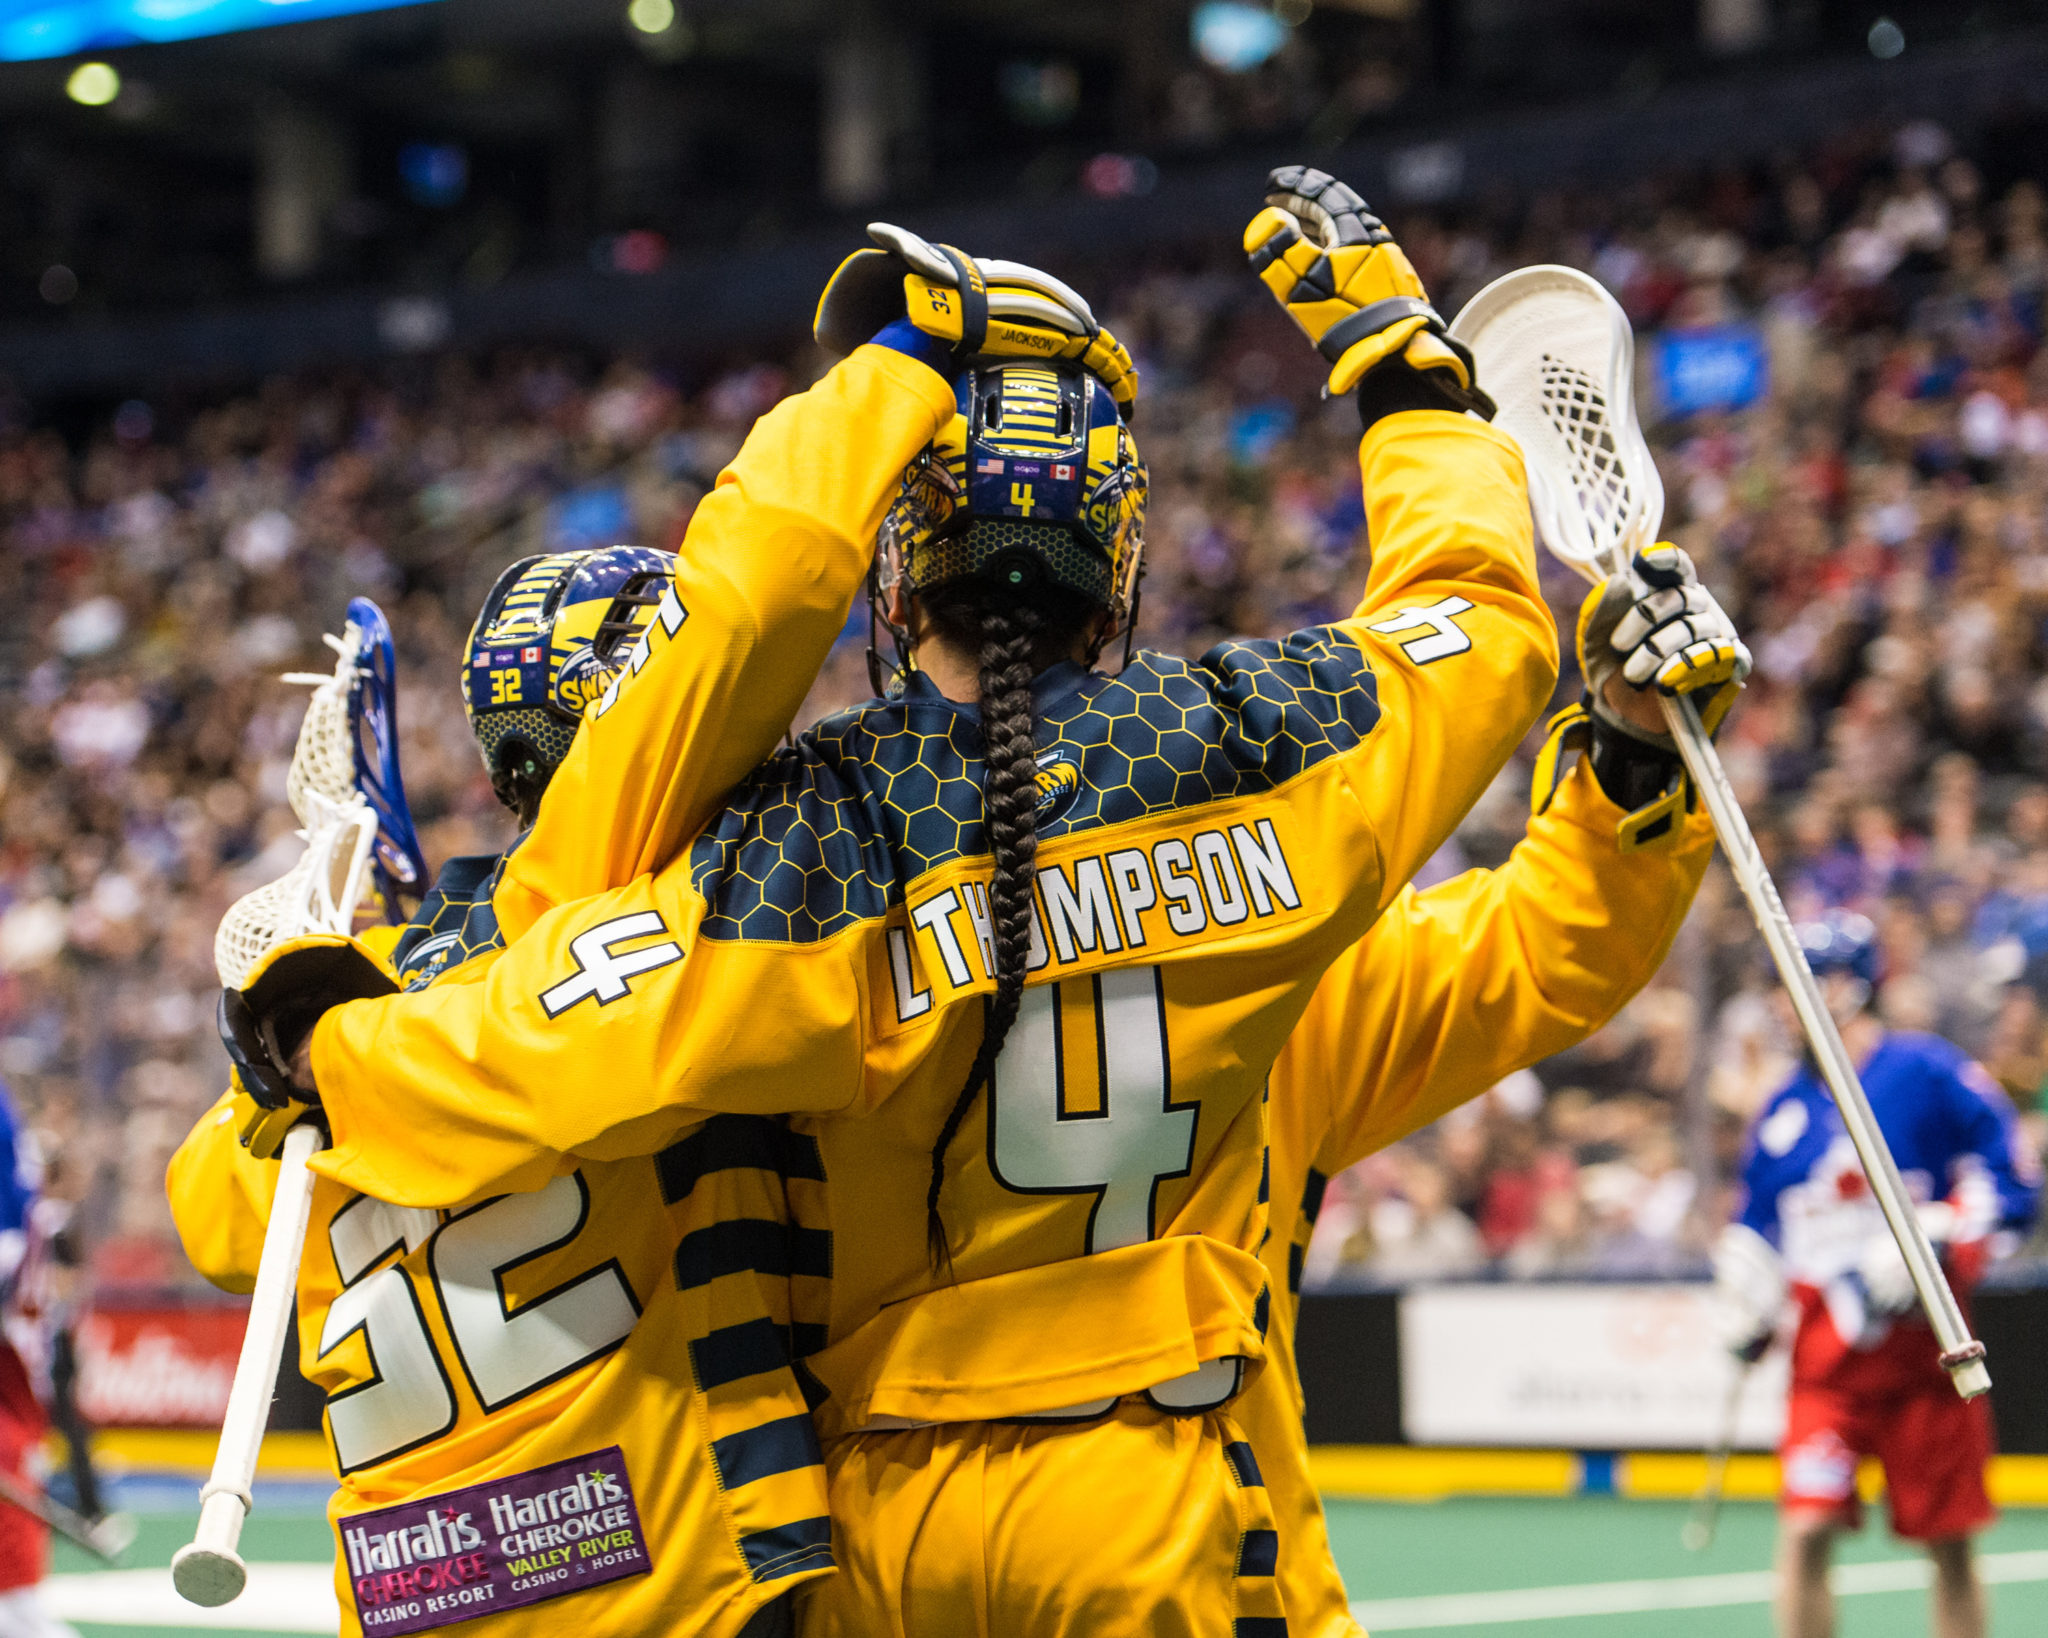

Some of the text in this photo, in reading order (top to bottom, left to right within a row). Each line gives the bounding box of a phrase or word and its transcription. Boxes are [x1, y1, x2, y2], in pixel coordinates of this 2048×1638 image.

[928, 288, 951, 315] 32
[1001, 329, 1055, 352] JACKSON
[1010, 482, 1036, 517] 4
[489, 667, 524, 705] 32
[538, 910, 686, 1021] 4
[985, 965, 1201, 1256] 4
[500, 1504, 632, 1558] CHEROKEE
[506, 1530, 636, 1578] VALLEY RIVER
[511, 1548, 642, 1592] CASINO & HOTEL
[357, 1553, 491, 1607] CHEROKEE
[363, 1584, 495, 1626] CASINO RESORT
